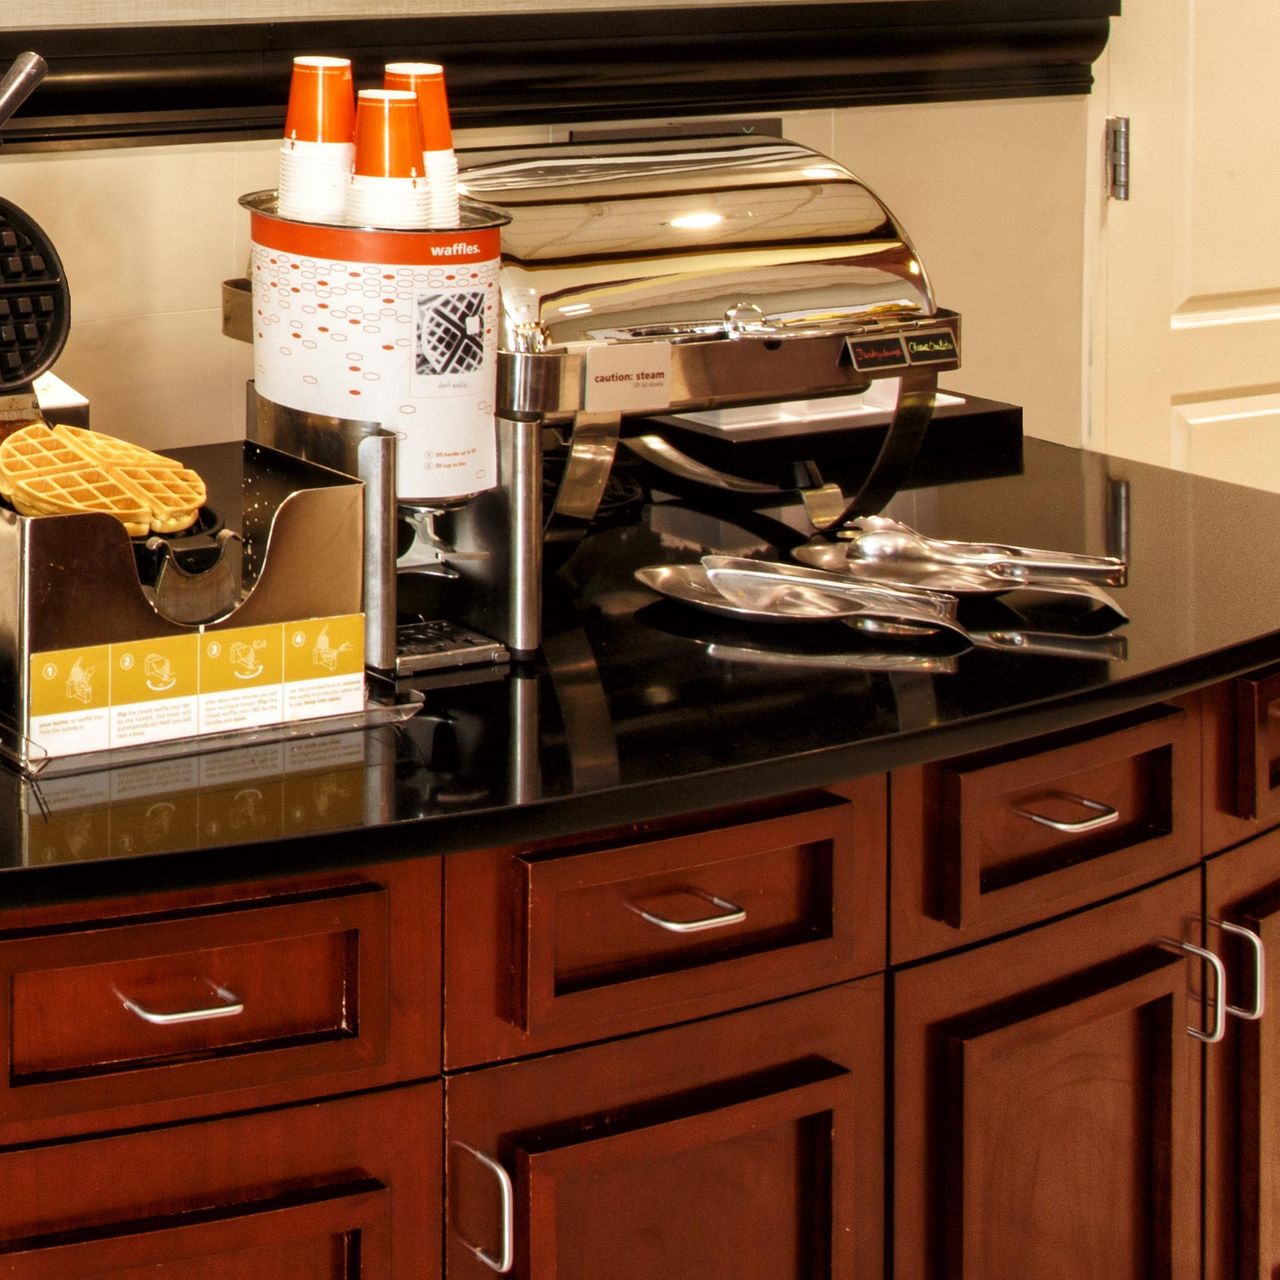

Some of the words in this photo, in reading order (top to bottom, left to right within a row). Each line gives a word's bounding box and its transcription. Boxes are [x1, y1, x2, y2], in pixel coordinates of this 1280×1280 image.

[430, 242, 481, 257] waffles.
[594, 372, 634, 383] caution:
[636, 371, 665, 380] steam
